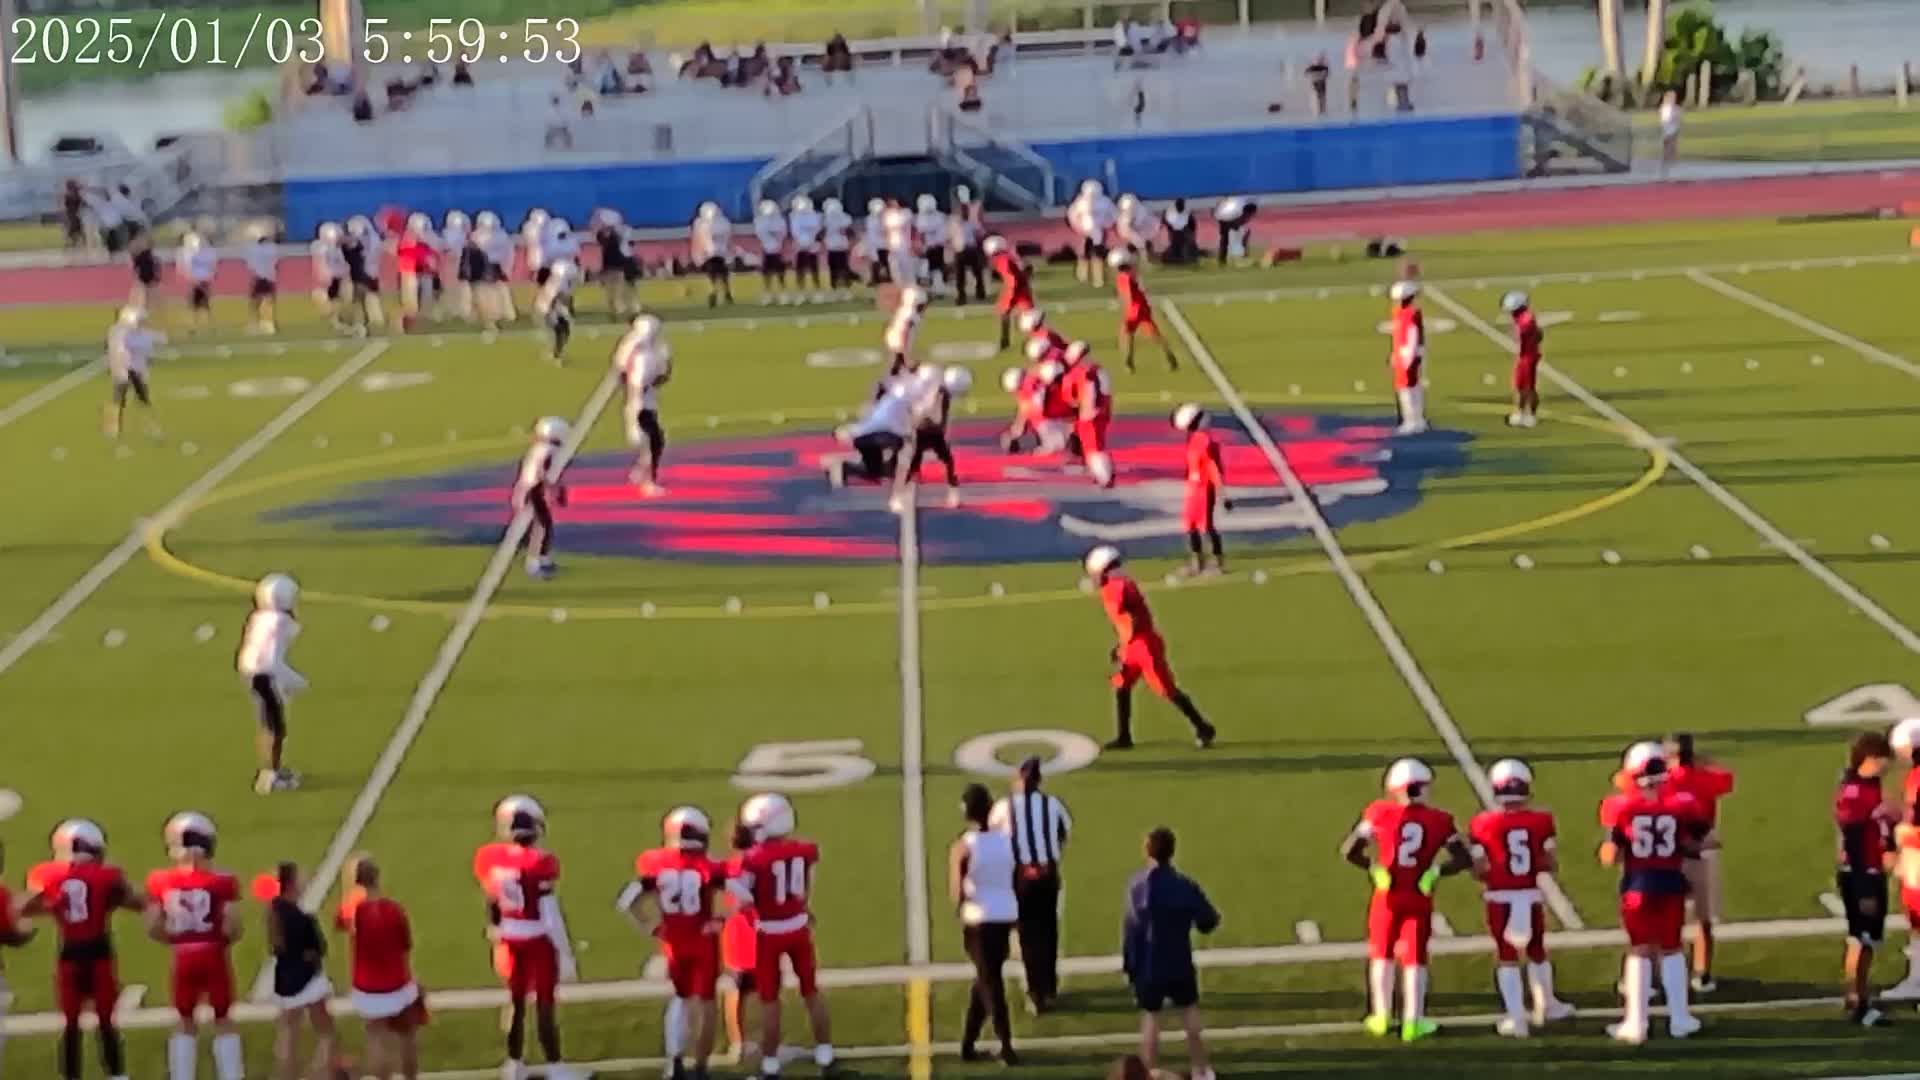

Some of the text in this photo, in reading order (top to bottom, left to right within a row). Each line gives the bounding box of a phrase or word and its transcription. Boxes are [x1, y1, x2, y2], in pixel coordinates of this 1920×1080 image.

[1399, 822, 1423, 866] 2
[1507, 828, 1530, 876] 5
[1631, 815, 1676, 858] 53
